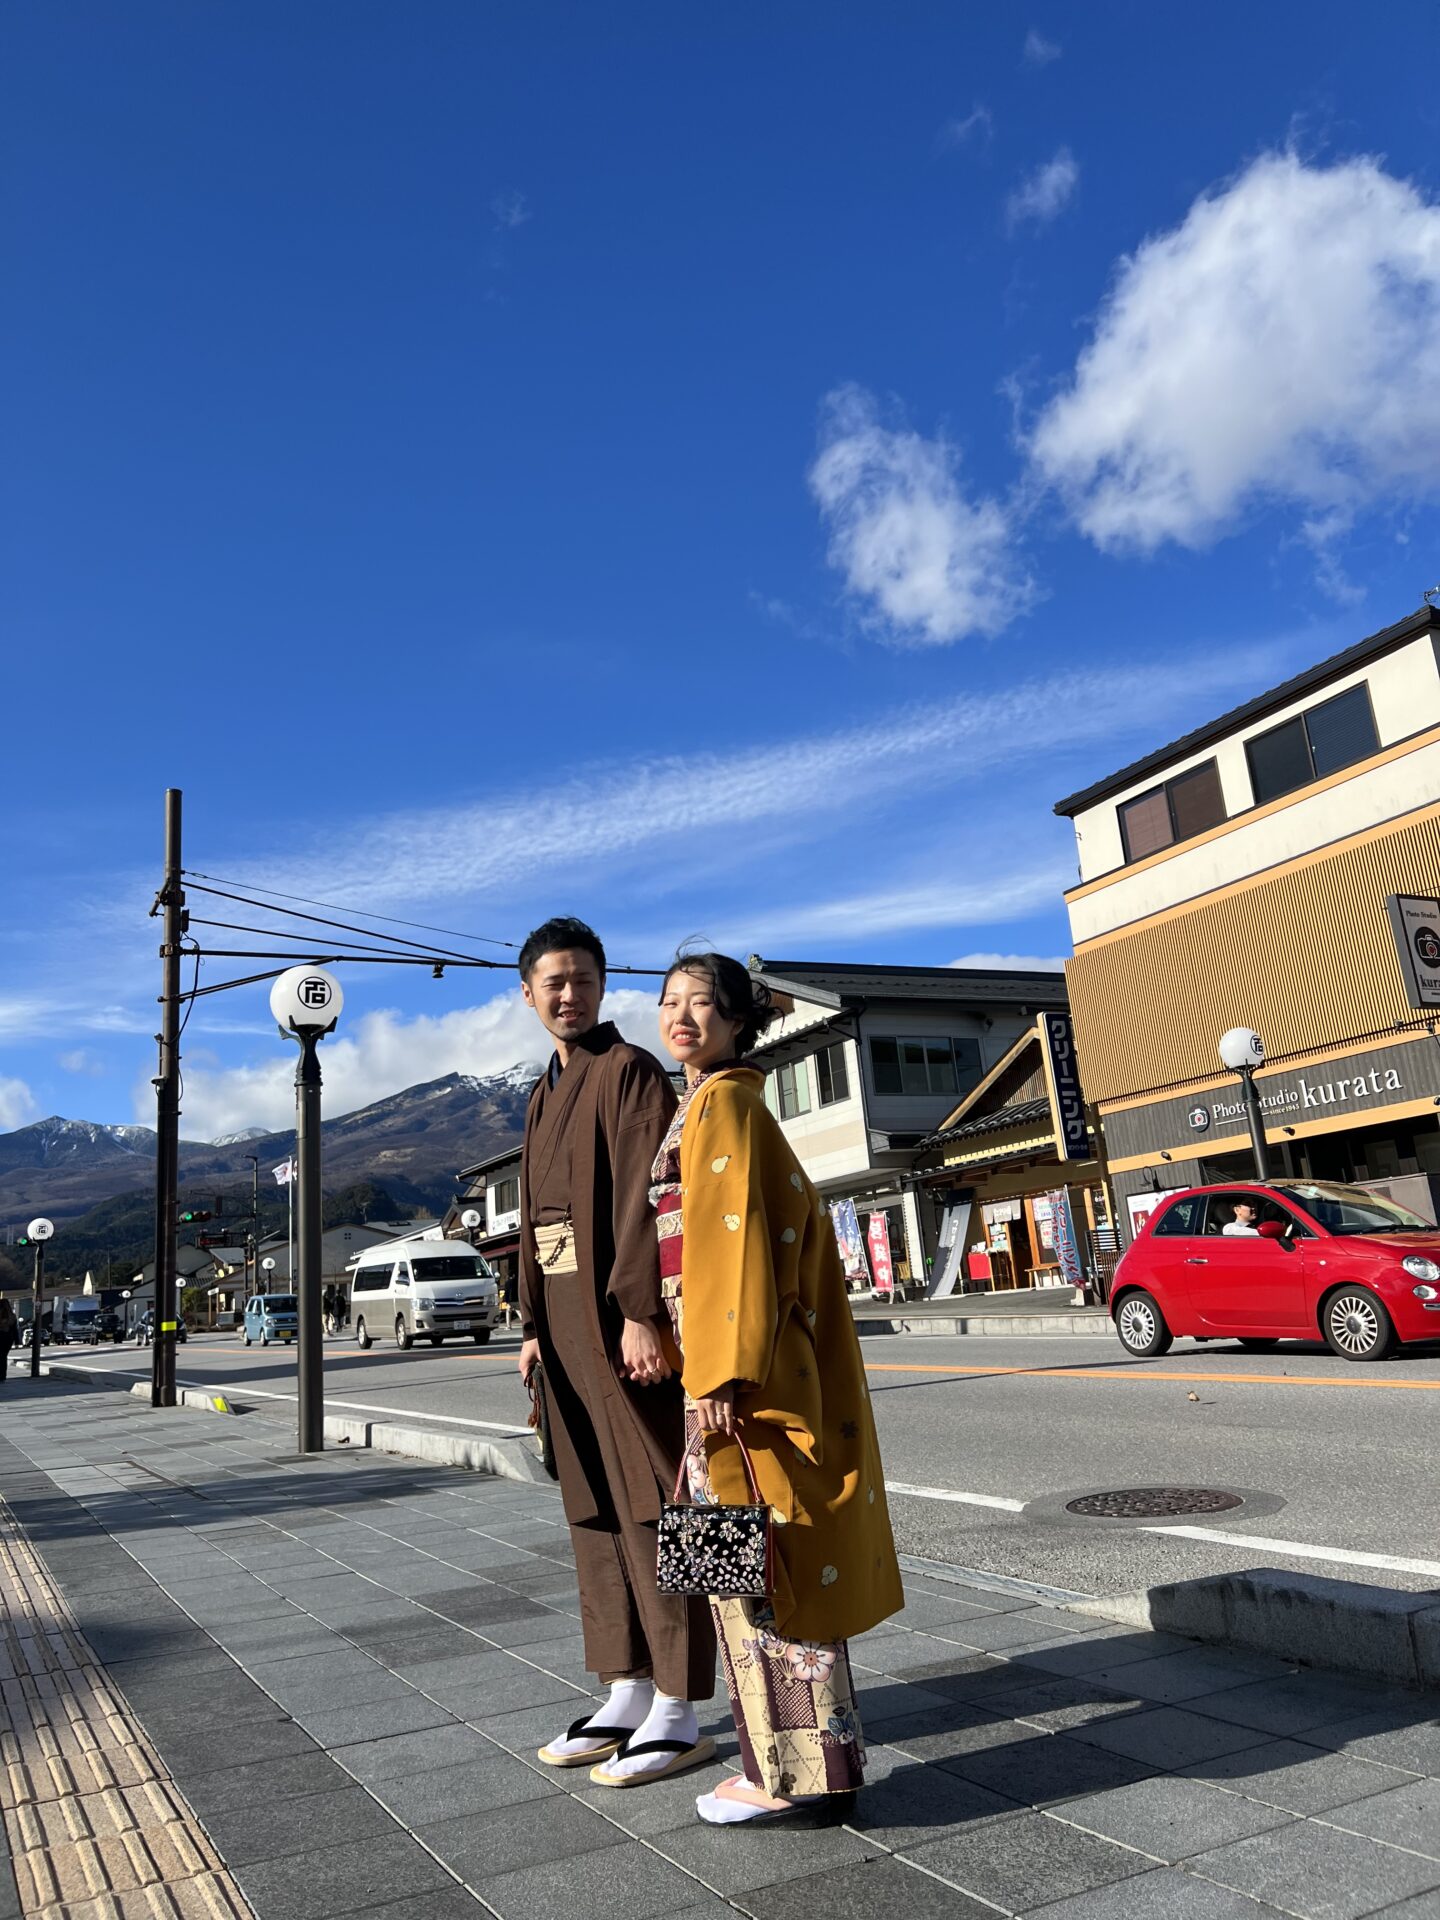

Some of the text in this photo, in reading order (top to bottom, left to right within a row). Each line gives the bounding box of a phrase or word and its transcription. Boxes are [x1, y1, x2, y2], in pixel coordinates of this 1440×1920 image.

[1419, 974, 1440, 988] kur
[1051, 1020, 1085, 1140] クリーニング
[1299, 1067, 1403, 1109] kurata
[1212, 1101, 1249, 1119] Photo
[1057, 1204, 1080, 1277] クリーニング
